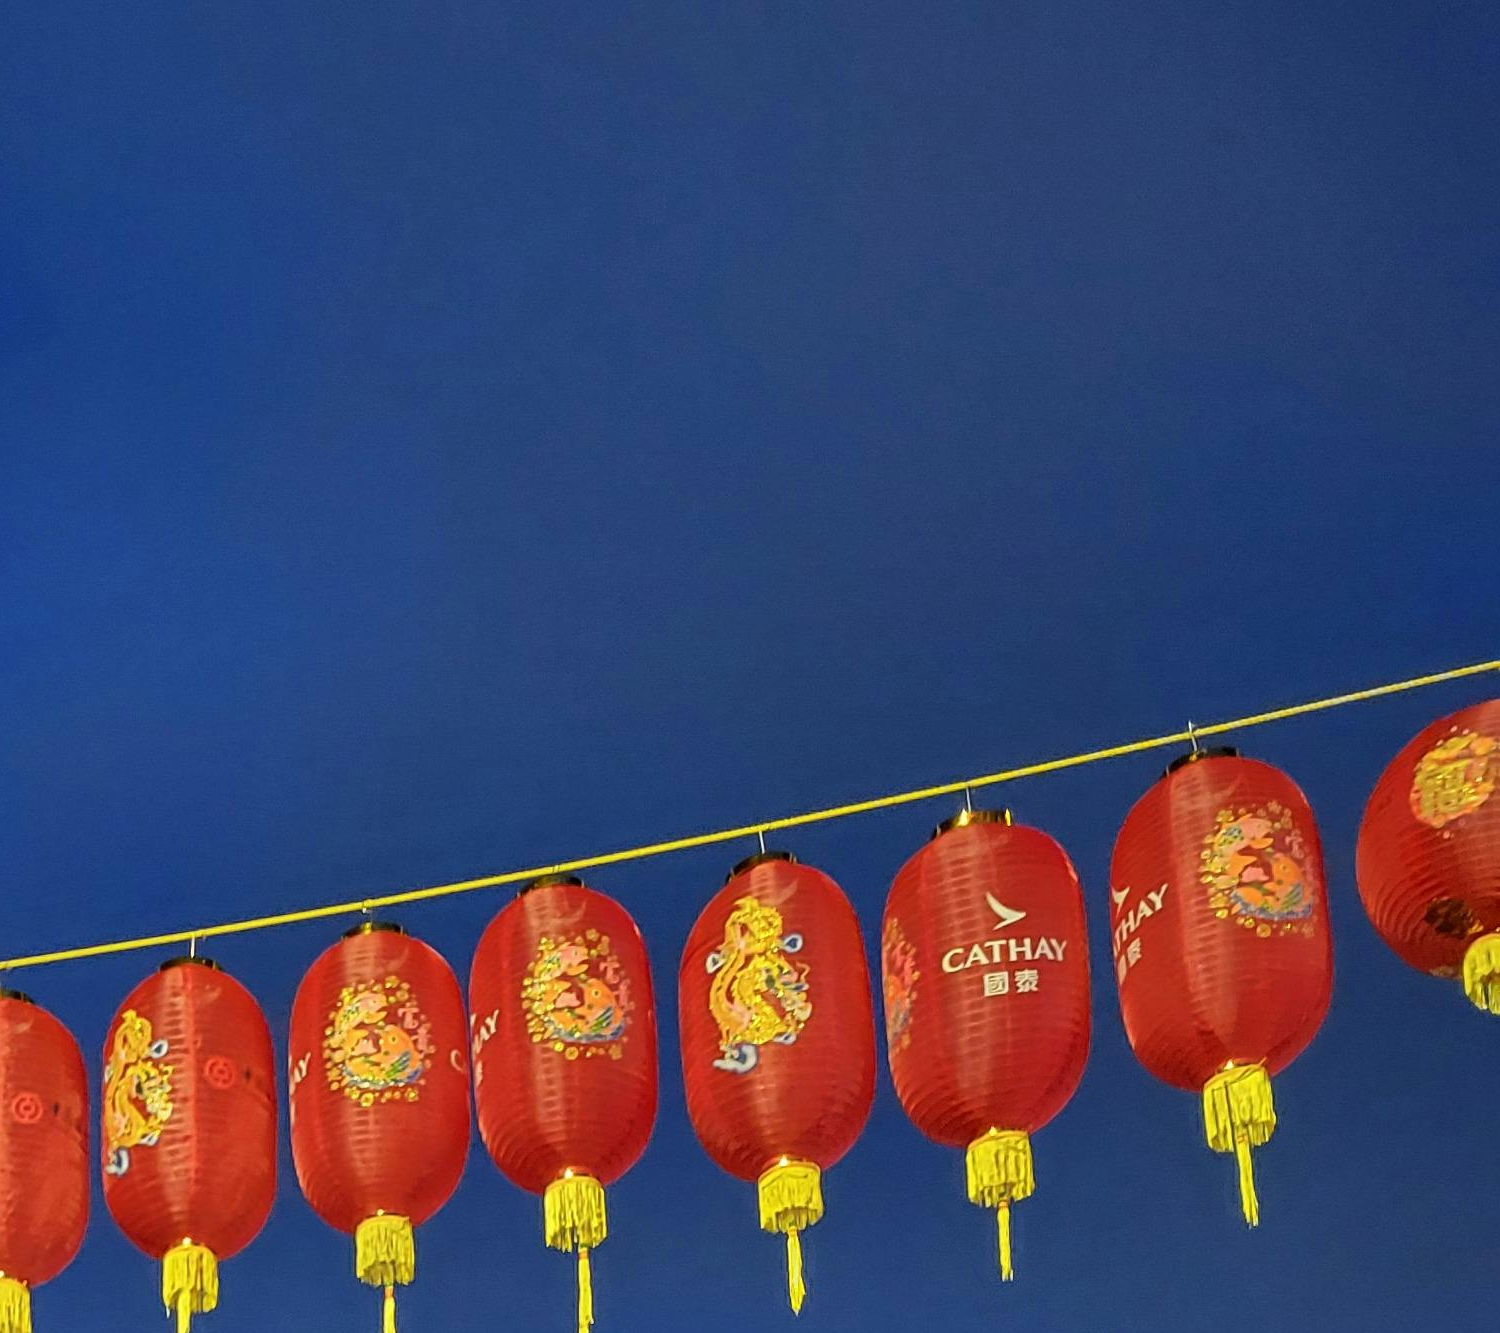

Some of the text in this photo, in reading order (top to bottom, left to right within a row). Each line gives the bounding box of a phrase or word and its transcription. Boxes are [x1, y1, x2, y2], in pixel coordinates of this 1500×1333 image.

[1113, 883, 1168, 960] THAY
[941, 936, 1067, 973] CATHAY
[983, 969, 1039, 997] 國泰
